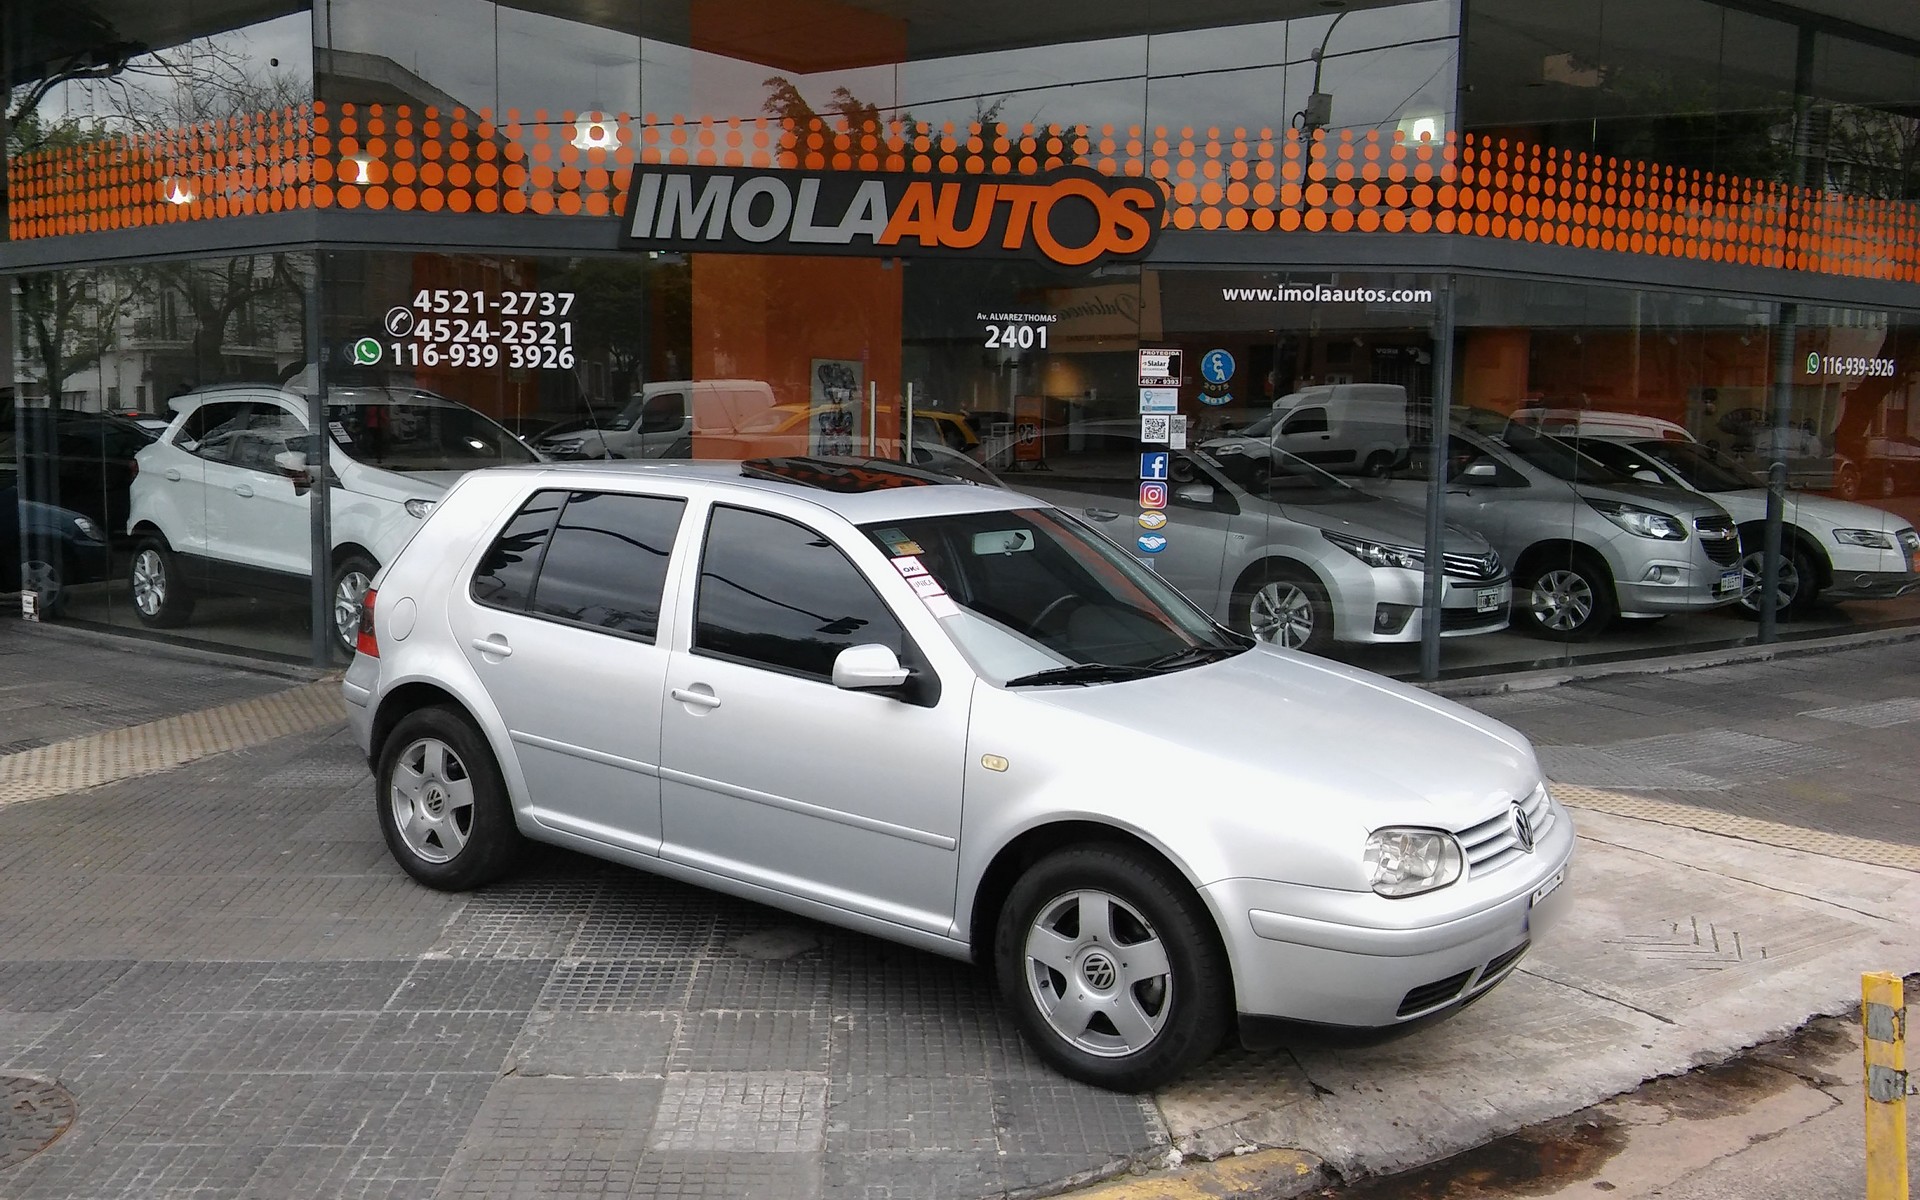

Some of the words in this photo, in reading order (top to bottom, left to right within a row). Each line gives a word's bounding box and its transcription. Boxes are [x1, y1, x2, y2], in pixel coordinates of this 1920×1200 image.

[413, 290, 575, 316] 4521-2737
[1222, 285, 1432, 303] www.imolaautos.com
[977, 312, 988, 320] Av.
[990, 313, 1023, 321] ALVAREZ
[1024, 314, 1057, 322] THOMAS
[413, 319, 574, 344] 4524-2521
[984, 325, 1047, 349] 2401
[391, 343, 499, 368] 116-939
[509, 345, 575, 370] 3926
[1822, 356, 1894, 376] 116-939-3926
